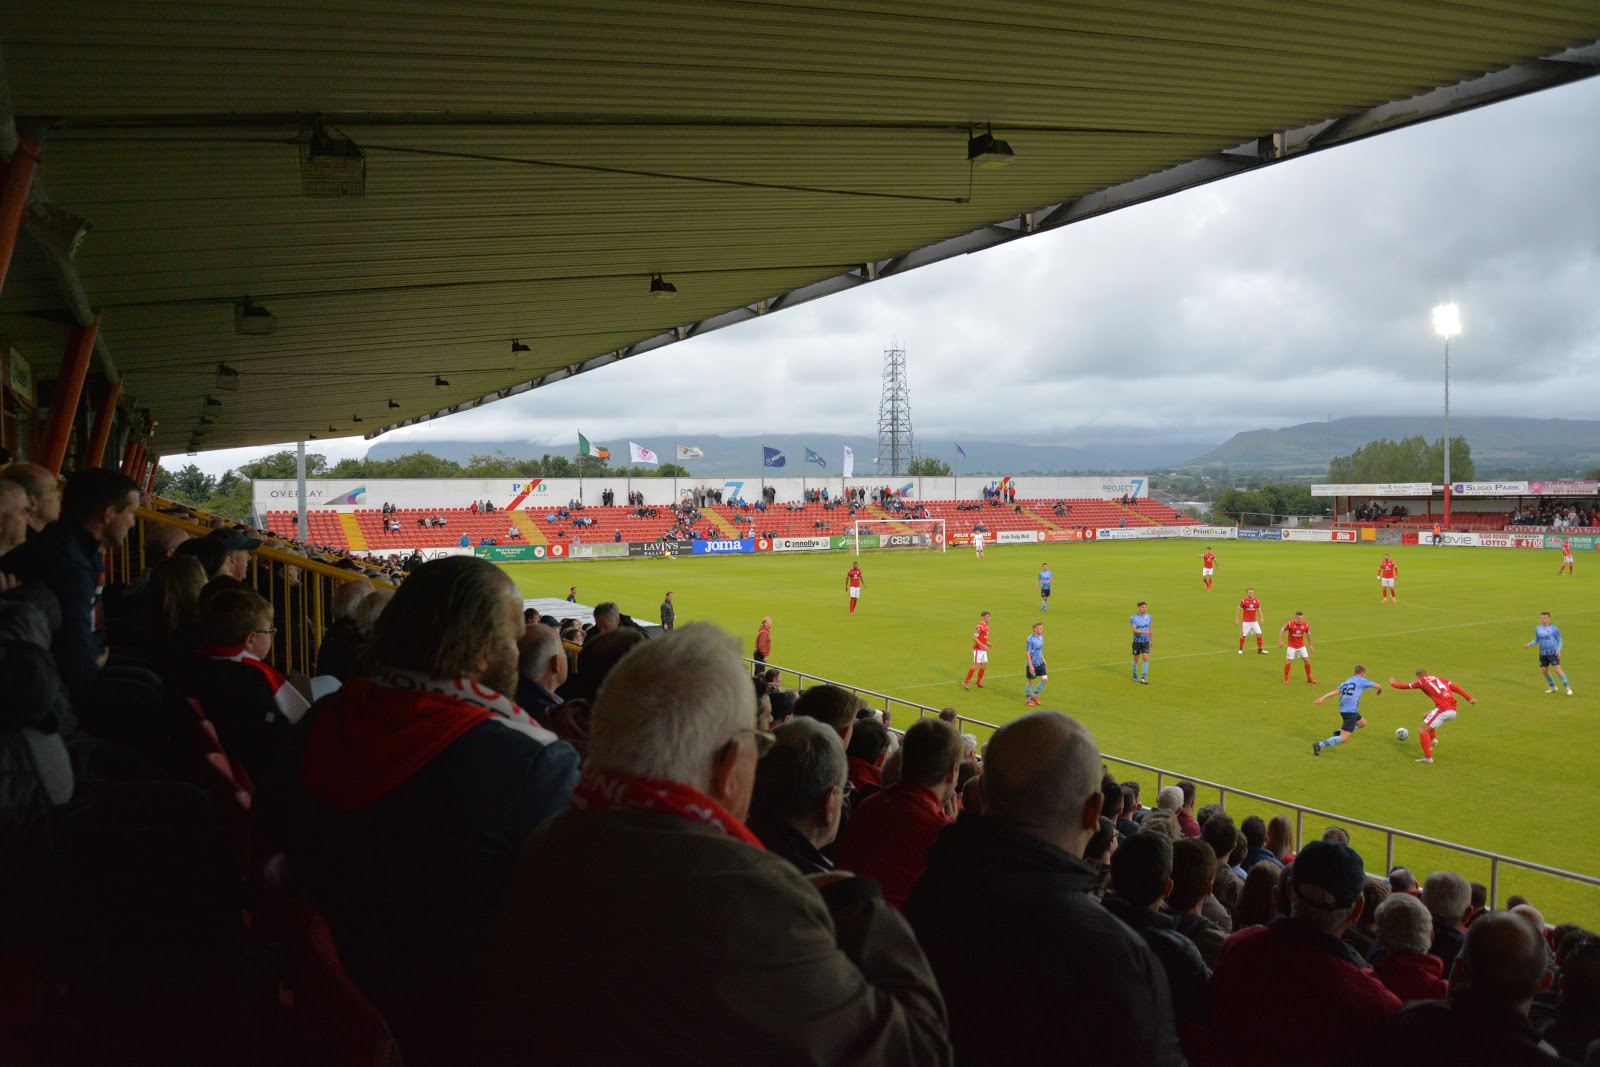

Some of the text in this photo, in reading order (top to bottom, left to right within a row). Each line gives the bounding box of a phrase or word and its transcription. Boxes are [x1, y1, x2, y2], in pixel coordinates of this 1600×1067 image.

[270, 490, 323, 498] OVEAY
[725, 482, 744, 502] 7
[1130, 480, 1144, 498] 7
[1193, 527, 1227, 535] Printfix.ie
[784, 539, 820, 548] Connollys
[1521, 539, 1543, 547] 4700
[1341, 682, 1356, 696] 22
[1428, 678, 1448, 694] 14
